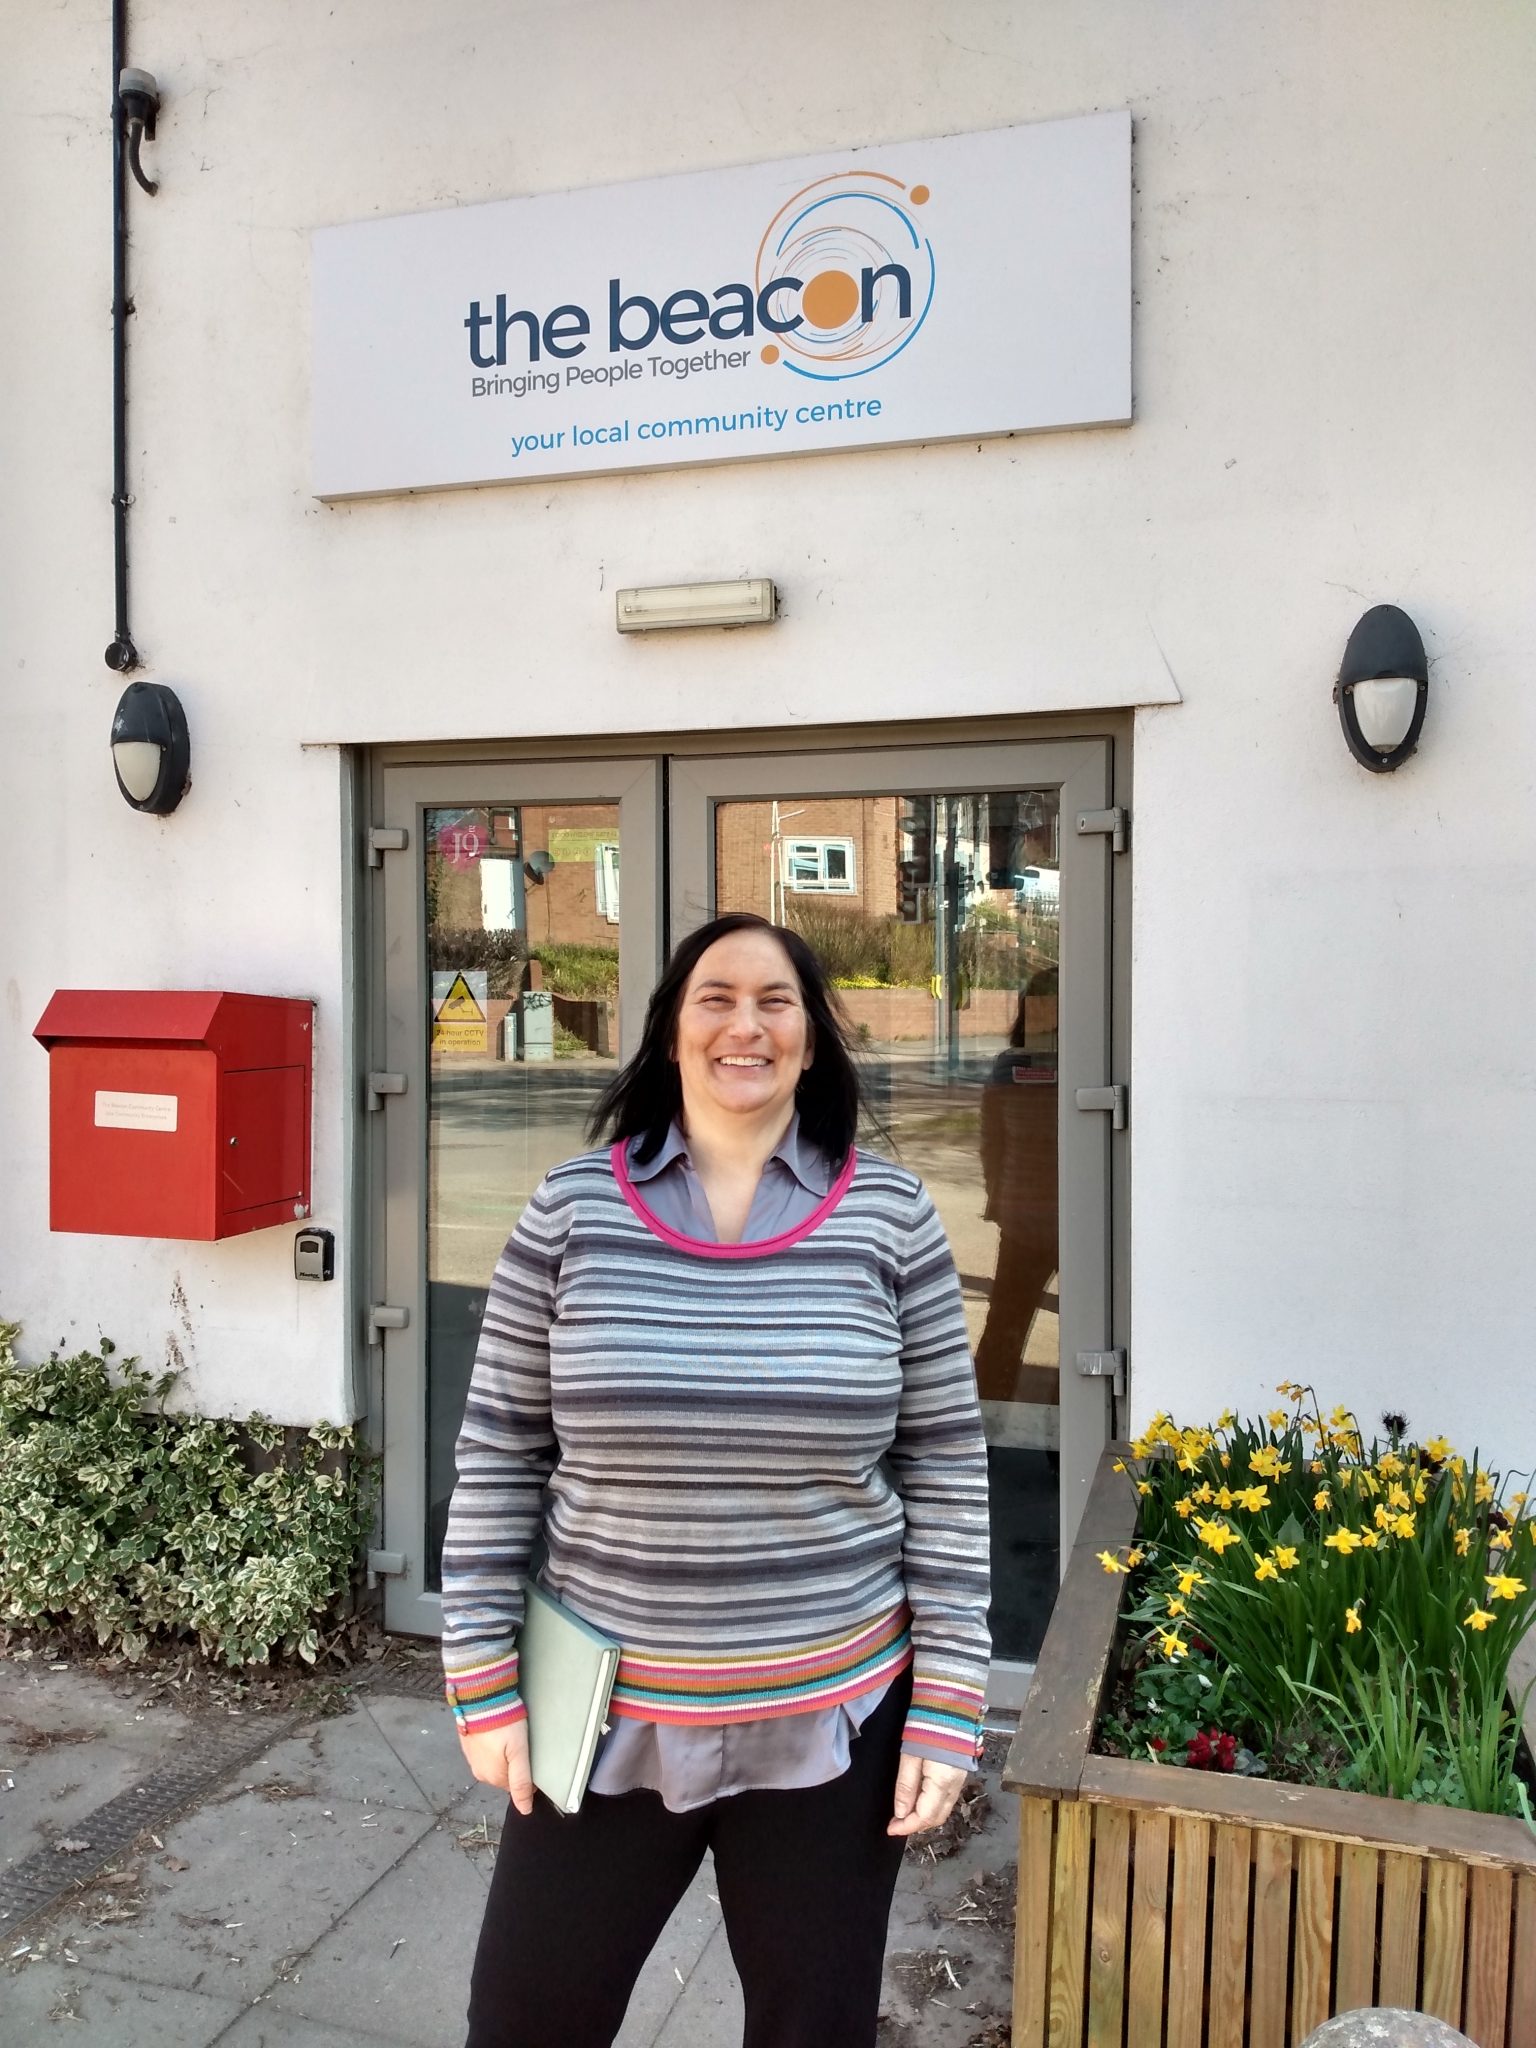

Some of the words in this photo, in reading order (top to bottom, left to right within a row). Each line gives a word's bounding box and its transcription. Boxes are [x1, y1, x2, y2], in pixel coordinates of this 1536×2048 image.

[464, 294, 590, 368] the
[609, 263, 911, 352] beacon
[472, 370, 560, 397] Bringing
[566, 359, 642, 387] People
[648, 349, 751, 379] Together
[512, 432, 565, 457] your
[573, 420, 629, 446] local
[637, 406, 788, 439] community
[796, 399, 881, 423] centre
[446, 1029, 462, 1037] hour
[464, 1029, 484, 1037] CCTV
[448, 1038, 481, 1047] operation
